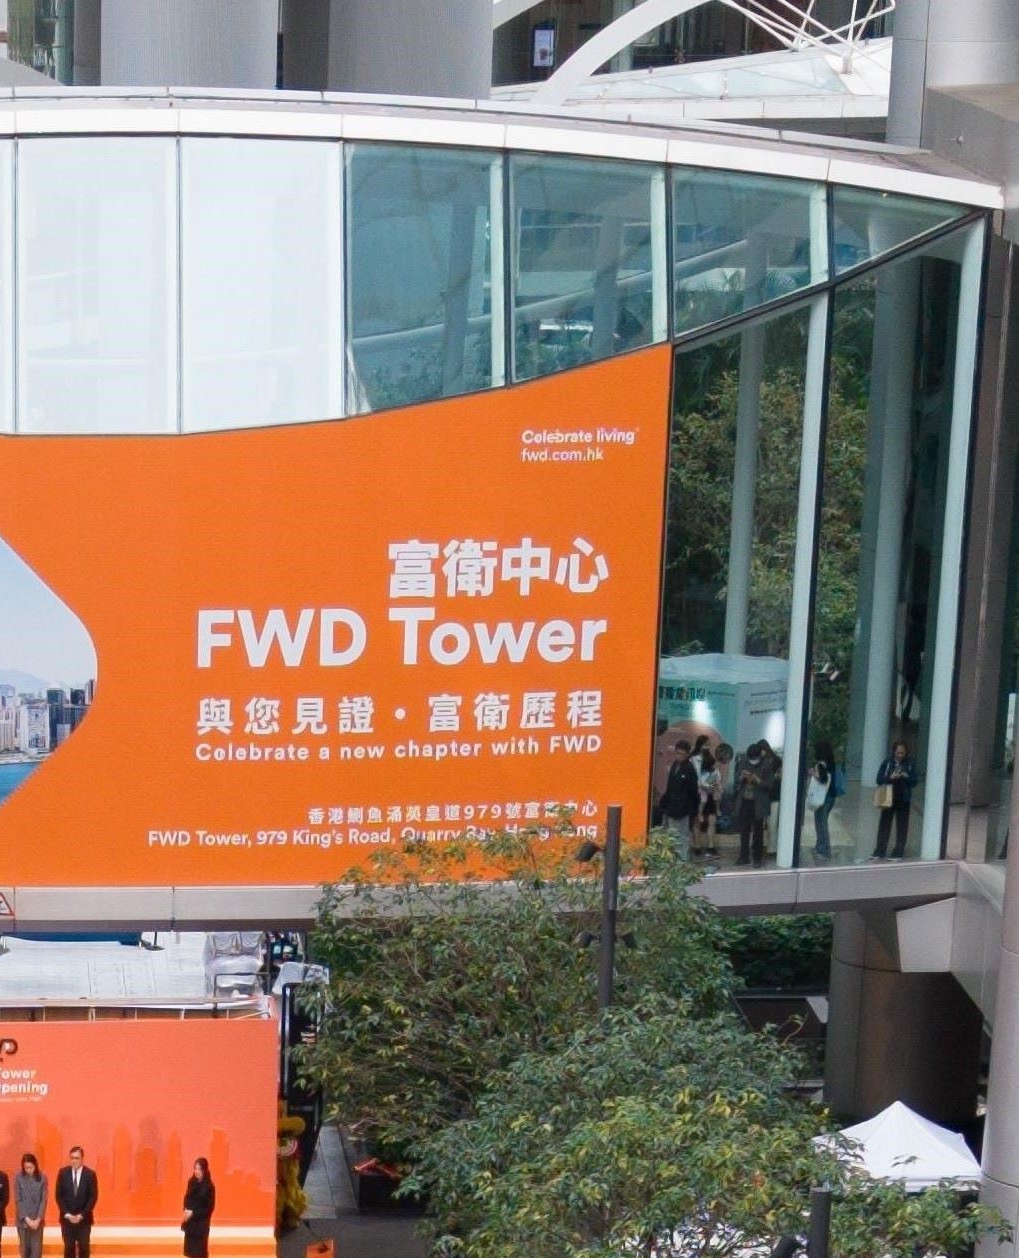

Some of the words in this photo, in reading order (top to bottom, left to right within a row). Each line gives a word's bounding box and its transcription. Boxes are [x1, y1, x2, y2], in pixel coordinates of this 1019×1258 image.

[521, 429, 592, 444] Celebrate
[596, 428, 635, 444] living
[521, 447, 604, 462] fwd.com.hk
[388, 536, 609, 599] 富衛中心
[196, 608, 367, 669] FWD
[388, 607, 608, 666] Tower
[195, 742, 309, 761] Celebrate
[318, 746, 330, 760] a
[340, 745, 385, 760] new
[394, 739, 483, 761] chapter
[491, 736, 540, 755] with
[549, 735, 602, 753] FWD
[148, 830, 191, 847] FWD
[195, 829, 252, 848] Tower,
[256, 829, 288, 845] 979
[348, 827, 396, 845] Road,
